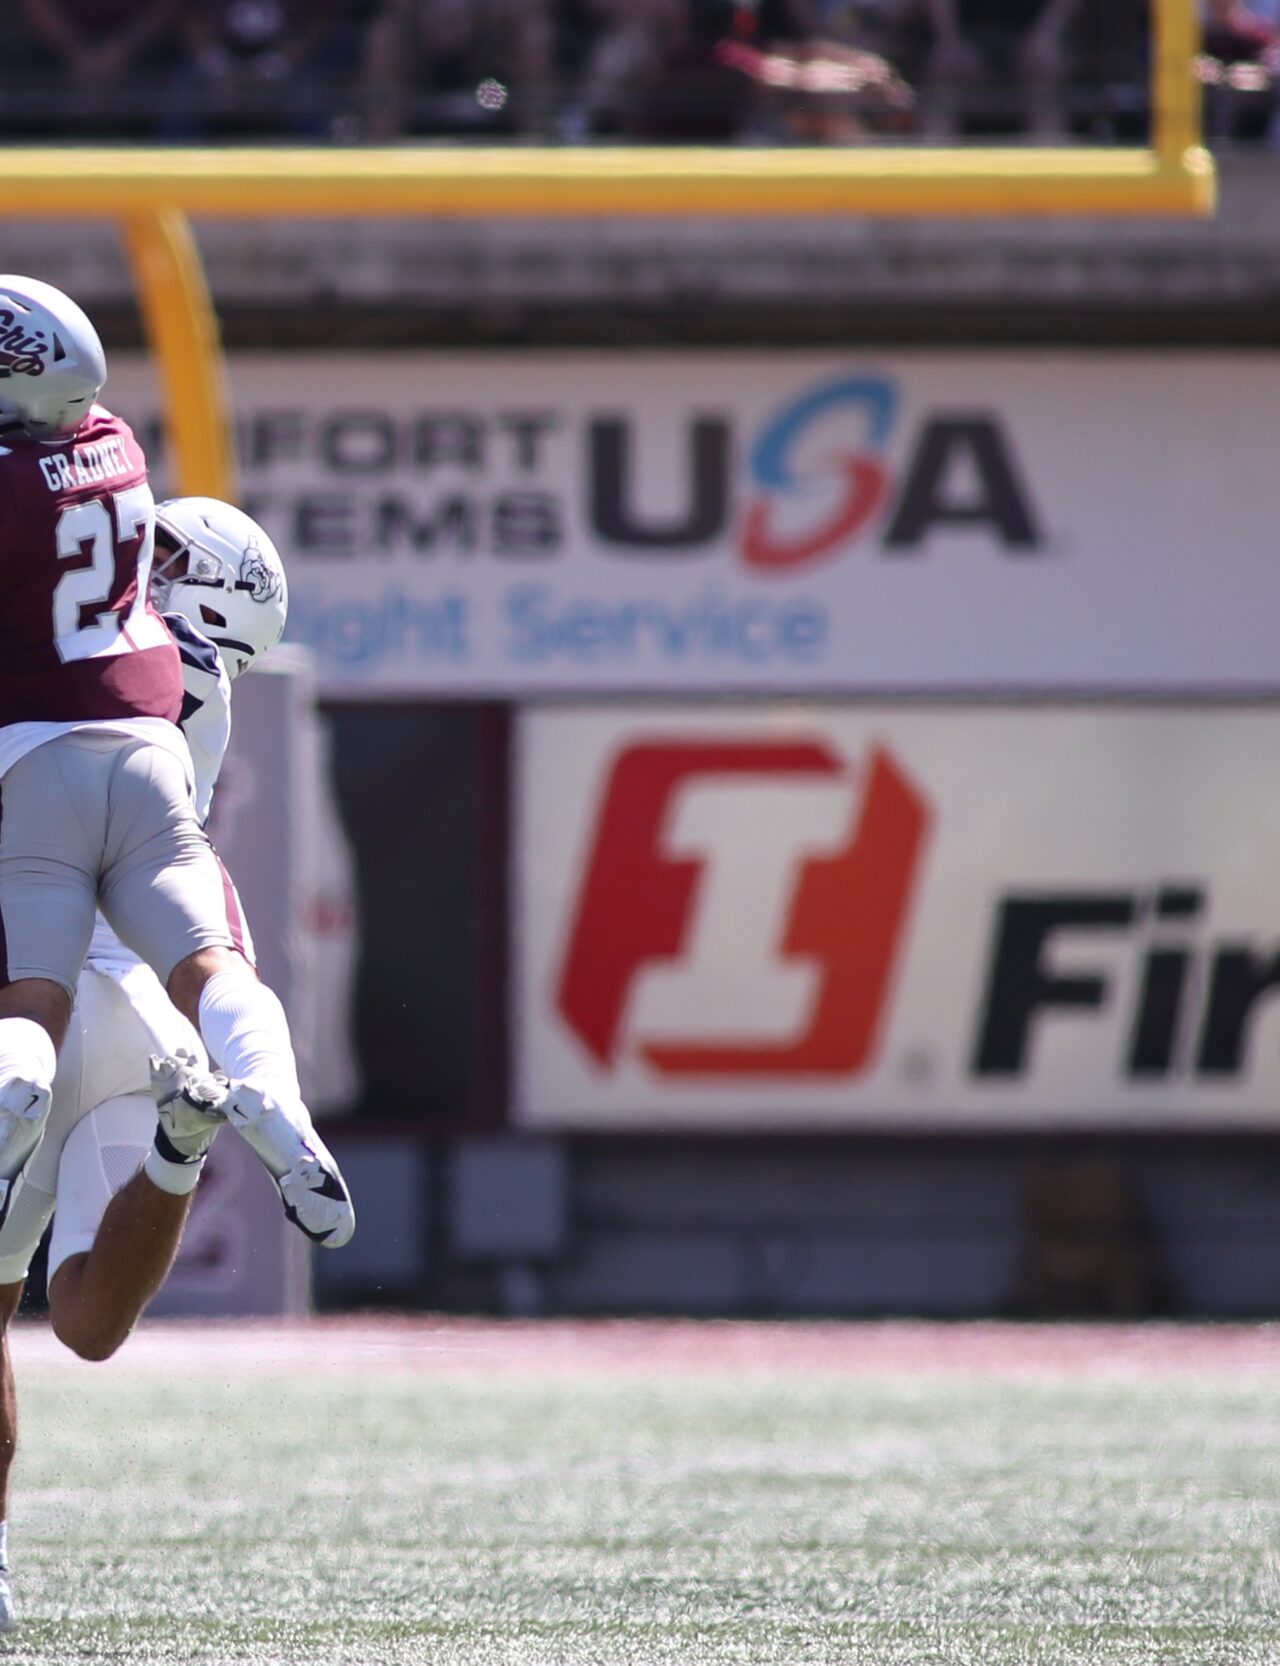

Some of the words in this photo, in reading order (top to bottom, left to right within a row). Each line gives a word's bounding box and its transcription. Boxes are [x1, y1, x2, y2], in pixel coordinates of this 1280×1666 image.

[39, 438, 135, 492] GRADNEY
[144, 408, 562, 474] FORT
[586, 366, 1046, 576] USA
[244, 492, 562, 558] EMS
[52, 483, 173, 664] 27
[287, 584, 468, 676] ight
[502, 580, 828, 664] Service
[970, 884, 1280, 1083] Fir
